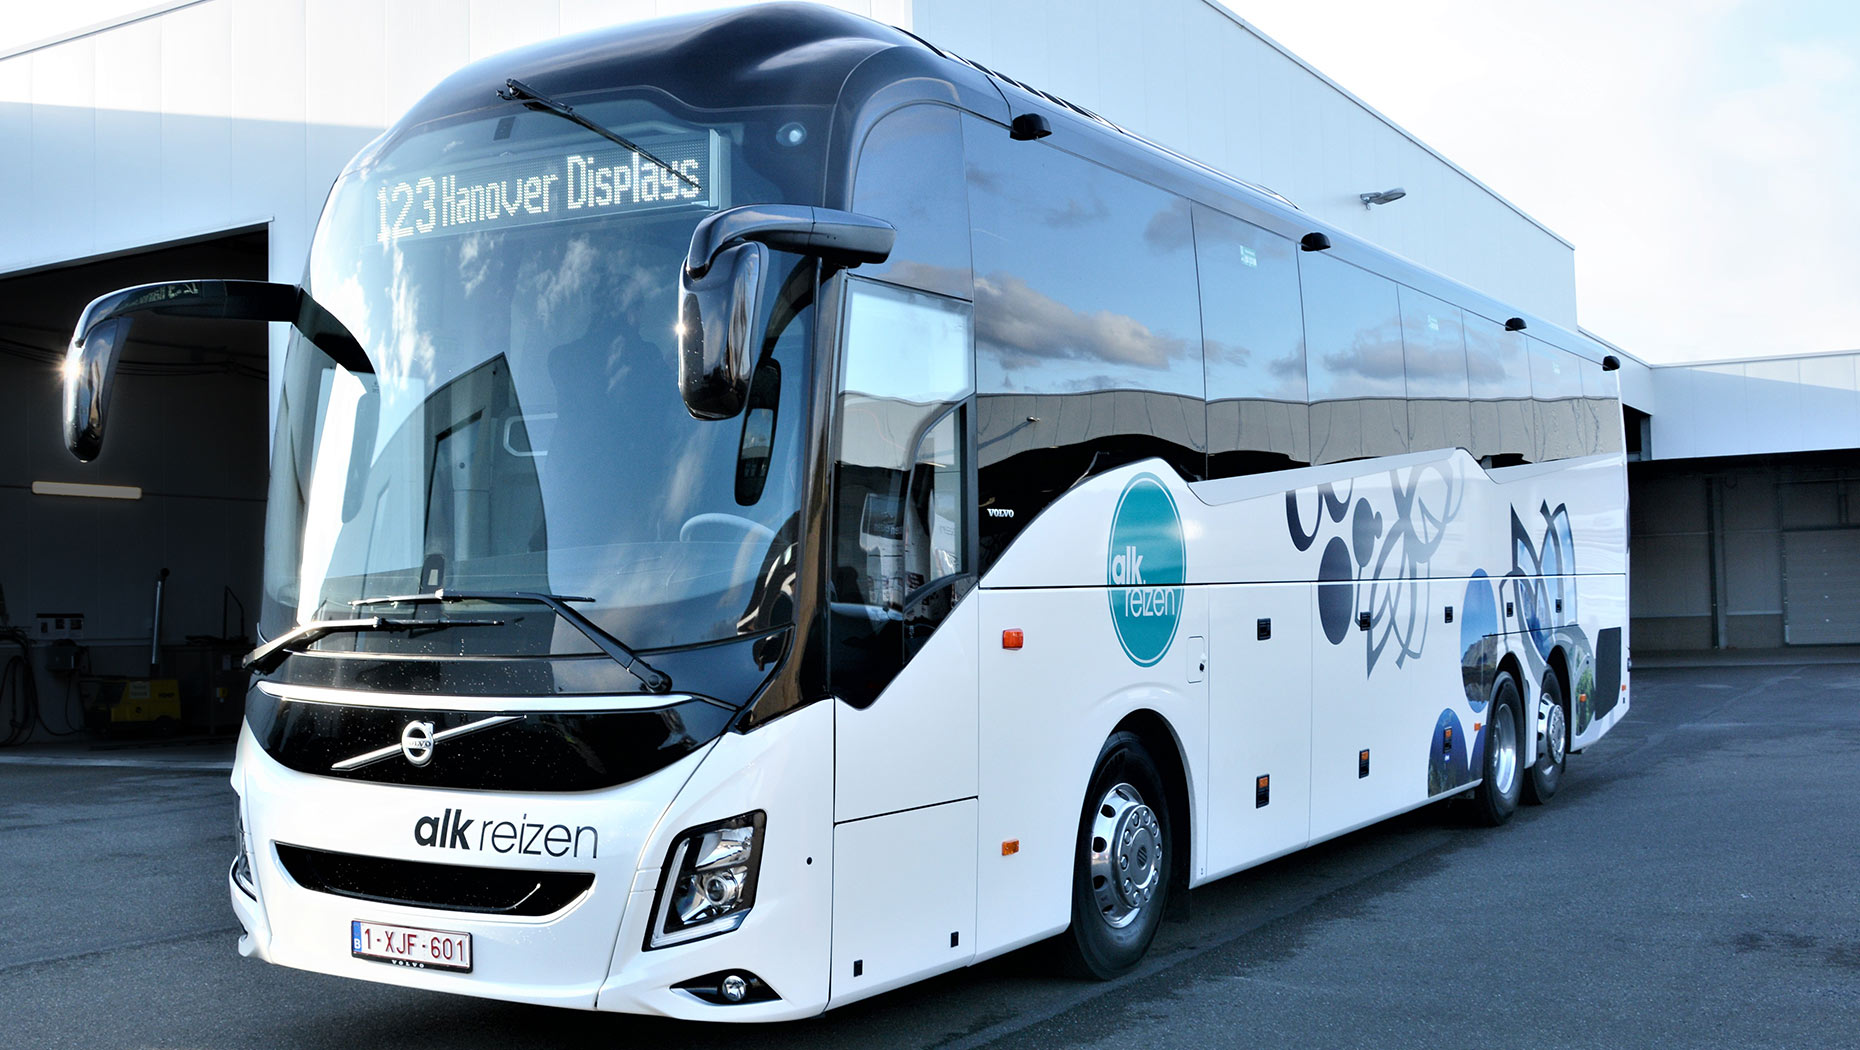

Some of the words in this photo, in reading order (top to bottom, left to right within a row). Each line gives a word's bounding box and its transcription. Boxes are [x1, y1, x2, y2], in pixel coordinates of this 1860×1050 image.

[377, 176, 436, 242] 123
[441, 173, 559, 226] Hanover
[567, 151, 700, 210] Displays
[987, 508, 1014, 518] VOLVO
[1112, 546, 1143, 585] alk
[1125, 580, 1175, 617] reizen
[414, 808, 475, 850] alk
[479, 813, 599, 859] reizen
[353, 938, 361, 949] B
[364, 928, 463, 962] 1-XJF-601
[391, 959, 425, 969] VOLVO
